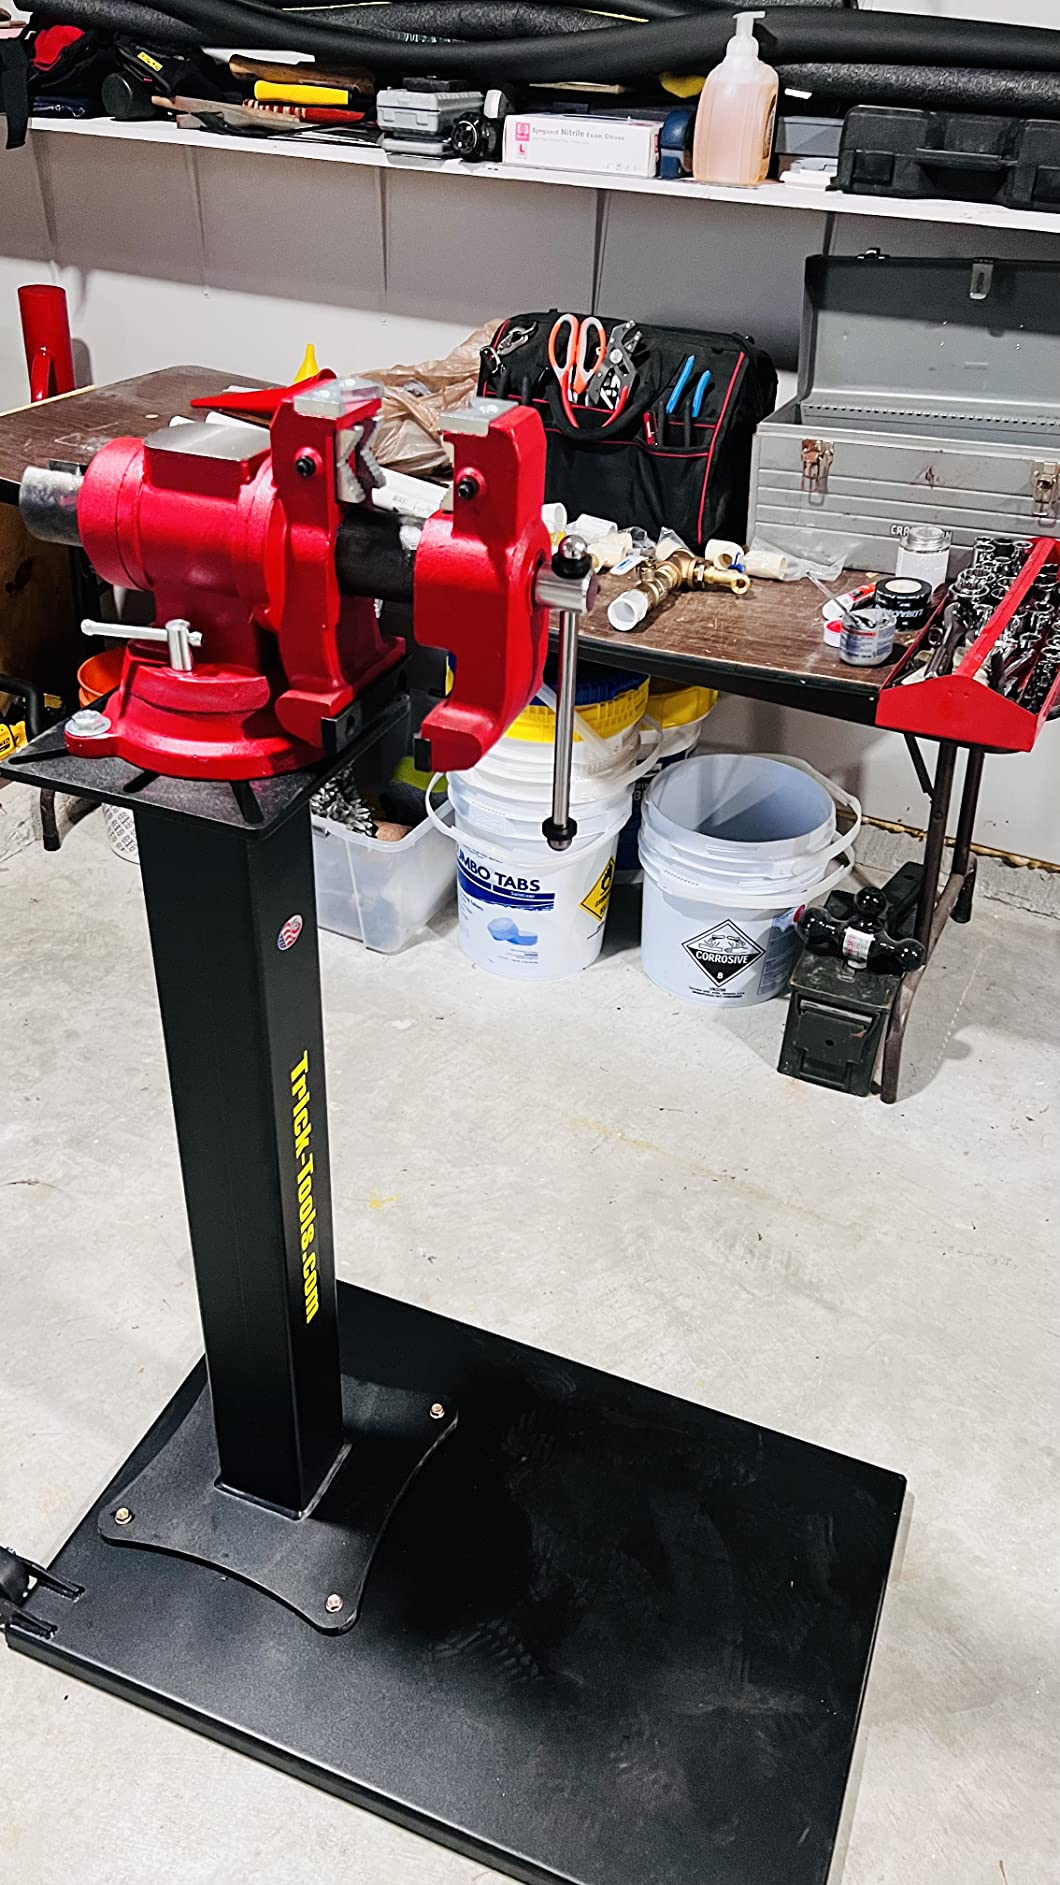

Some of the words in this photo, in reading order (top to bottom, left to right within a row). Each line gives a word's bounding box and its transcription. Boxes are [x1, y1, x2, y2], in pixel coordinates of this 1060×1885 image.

[561, 127, 585, 138] Nitrile
[586, 130, 602, 139] Exam
[519, 144, 526, 153] L
[494, 871, 541, 892] TABS
[695, 950, 749, 965] CORROSIVE
[716, 971, 724, 980] 8
[289, 1050, 319, 1324] Trick-Tools.com
